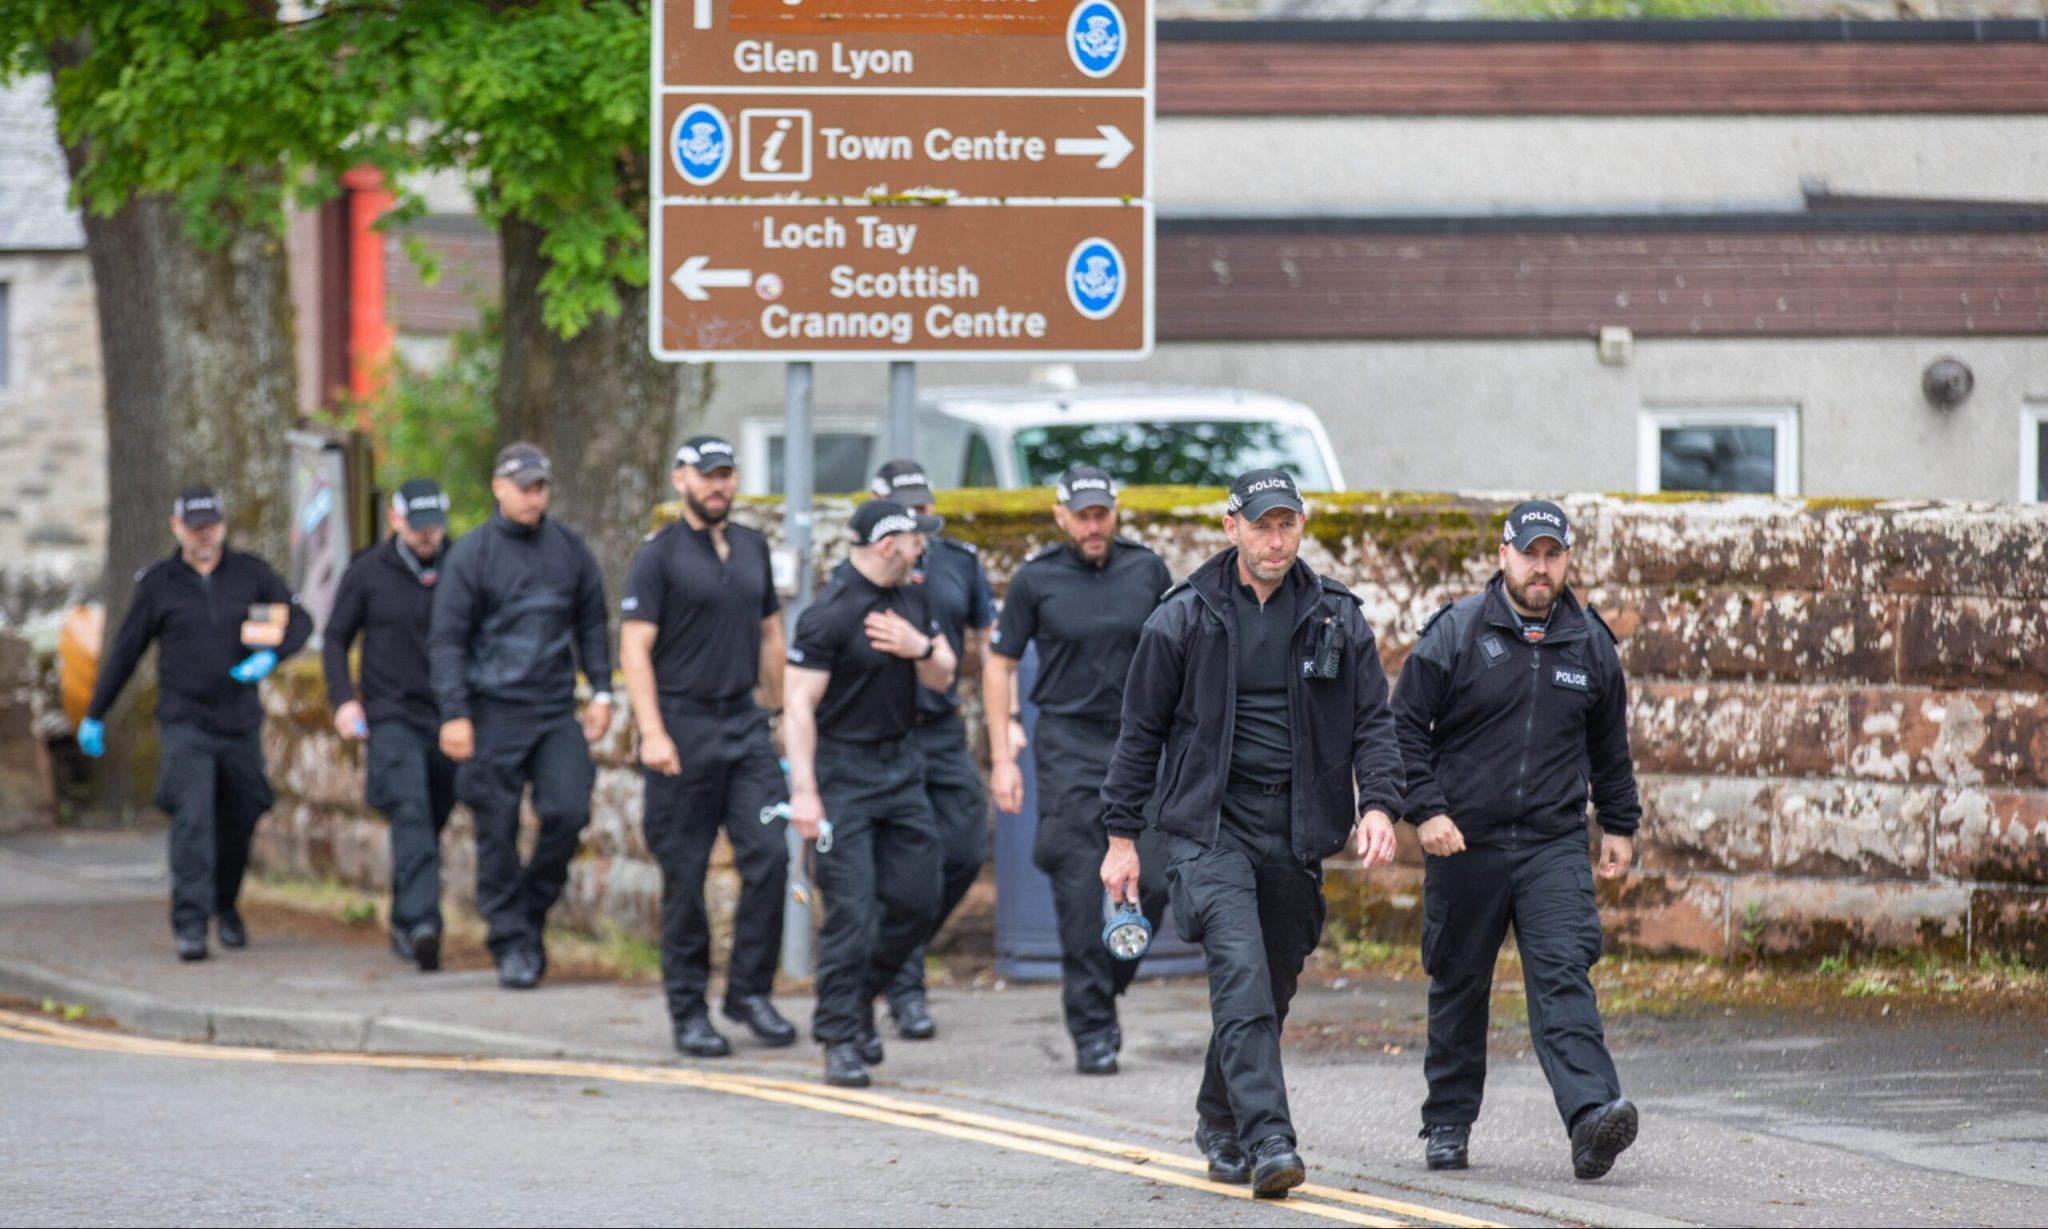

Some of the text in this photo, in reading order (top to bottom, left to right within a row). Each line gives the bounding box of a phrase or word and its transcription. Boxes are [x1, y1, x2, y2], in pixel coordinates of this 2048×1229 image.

[734, 40, 913, 80] Glen Lyon
[819, 127, 1046, 161] Town Centre
[763, 215, 917, 255] Loch Tay
[830, 264, 979, 299] Scottish
[760, 304, 1047, 344] Crannog Centre
[1248, 479, 1288, 494] POLICE
[1521, 512, 1561, 527] POLICE
[1555, 670, 1588, 686] POLICE
